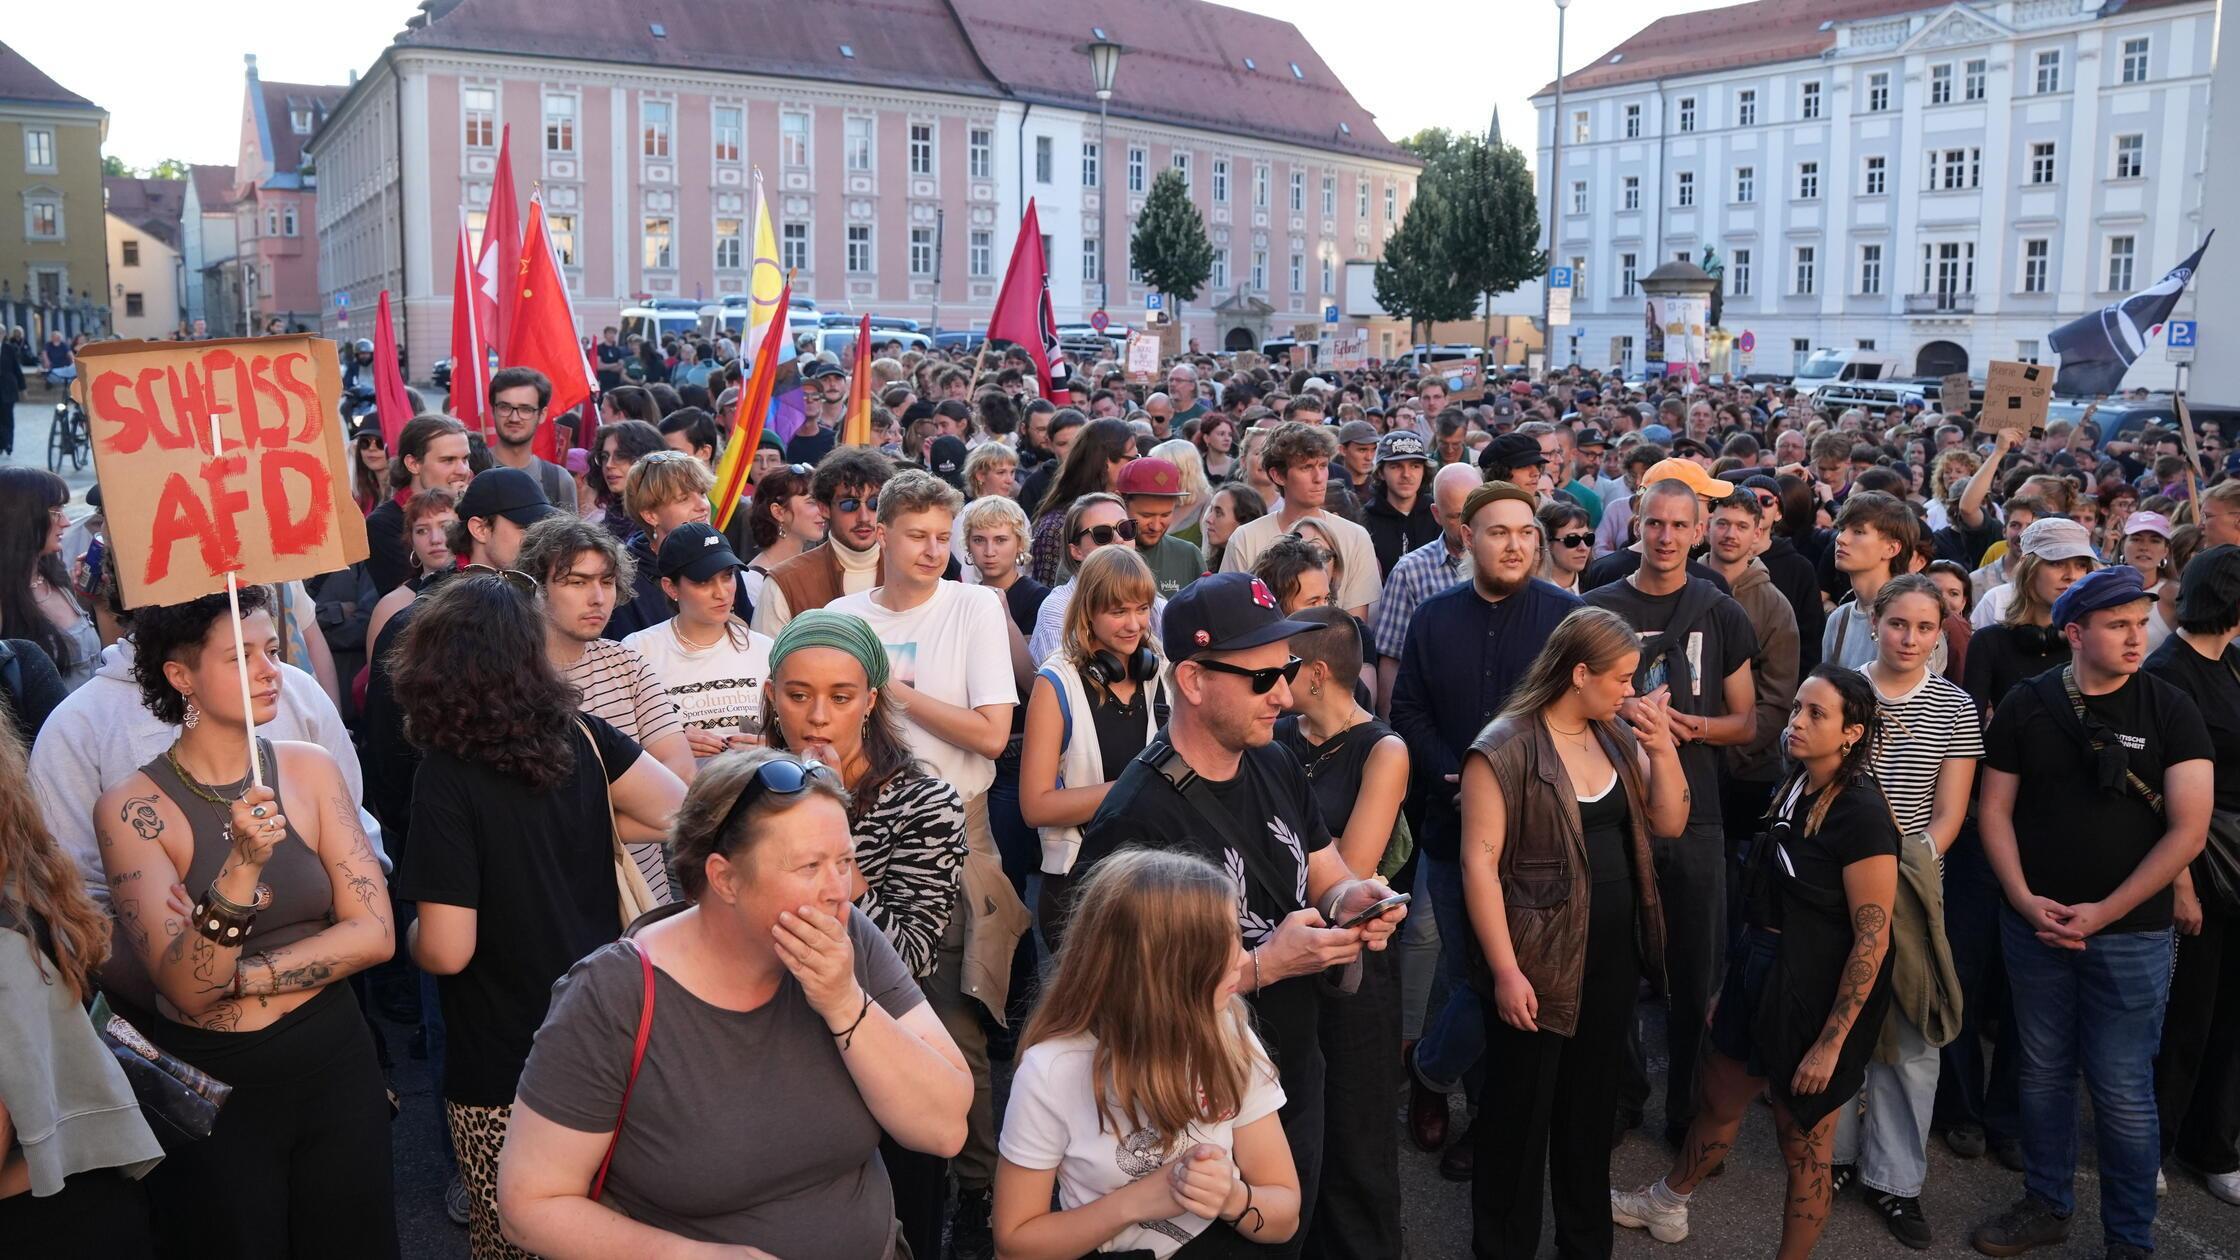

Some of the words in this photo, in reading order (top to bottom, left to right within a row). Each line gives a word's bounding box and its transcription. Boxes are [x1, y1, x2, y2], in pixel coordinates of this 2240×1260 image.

[1554, 269, 1567, 286] P
[1149, 296, 1158, 308] P
[1328, 308, 1336, 321] P
[2172, 324, 2189, 344] P
[91, 349, 323, 455] SCHEISS
[144, 449, 333, 585] AFD
[681, 690, 758, 709] Columbia
[682, 707, 725, 720] Sportswear
